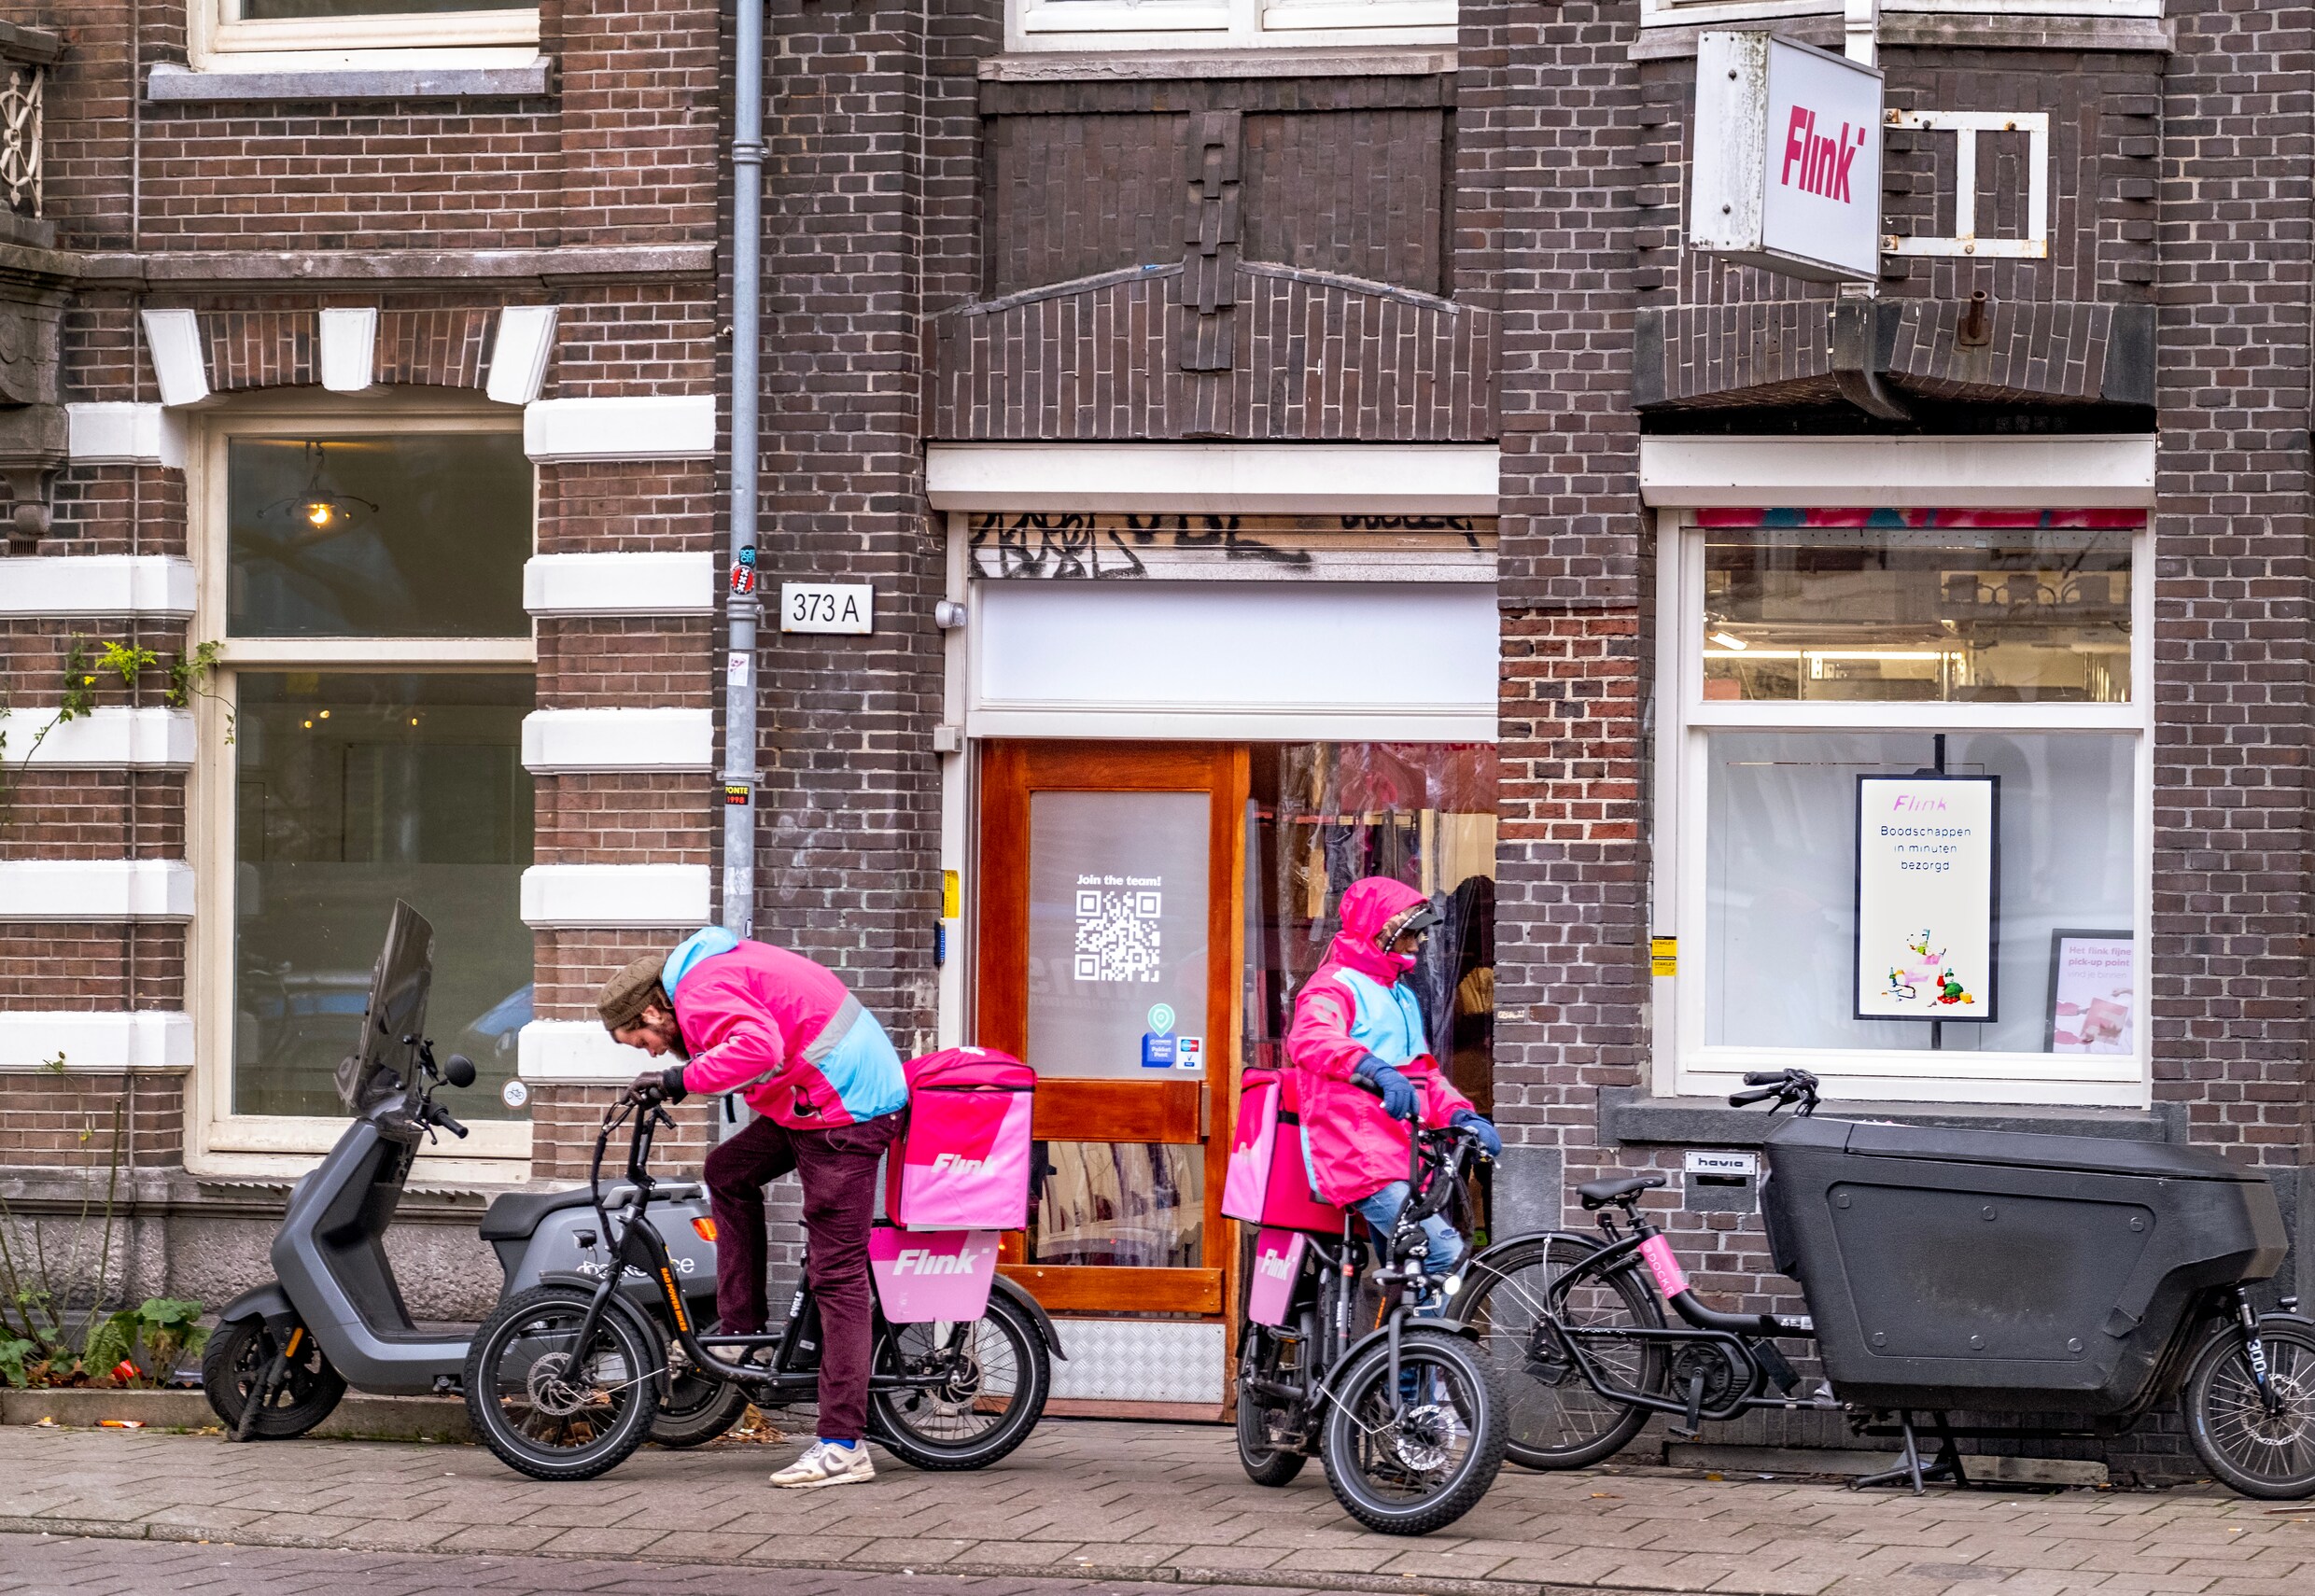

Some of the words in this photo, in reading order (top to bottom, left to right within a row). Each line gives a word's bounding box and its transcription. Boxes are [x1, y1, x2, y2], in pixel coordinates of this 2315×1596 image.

[1781, 105, 1866, 204] Flink
[793, 593, 835, 623] 373
[841, 595, 860, 623] A
[1893, 794, 1947, 811] Flink
[1880, 825, 1971, 838] Boodschappen
[1894, 845, 1904, 853] in
[1908, 845, 1957, 854] minuten
[1901, 861, 1950, 873] bezorgd
[1076, 875, 1101, 885] Join
[1103, 875, 1124, 886] the
[1126, 875, 1162, 887] team!
[2088, 946, 2109, 955] flink
[2111, 947, 2132, 957] fijne
[2069, 958, 2103, 967] pick-up
[2105, 959, 2130, 967] point
[931, 1153, 997, 1176] Flink
[1698, 1157, 1744, 1167] havia
[892, 1248, 990, 1276] Flink
[1260, 1248, 1297, 1281] Flink
[1648, 1253, 1676, 1295] DOCKR
[2247, 1338, 2267, 1373] 300
